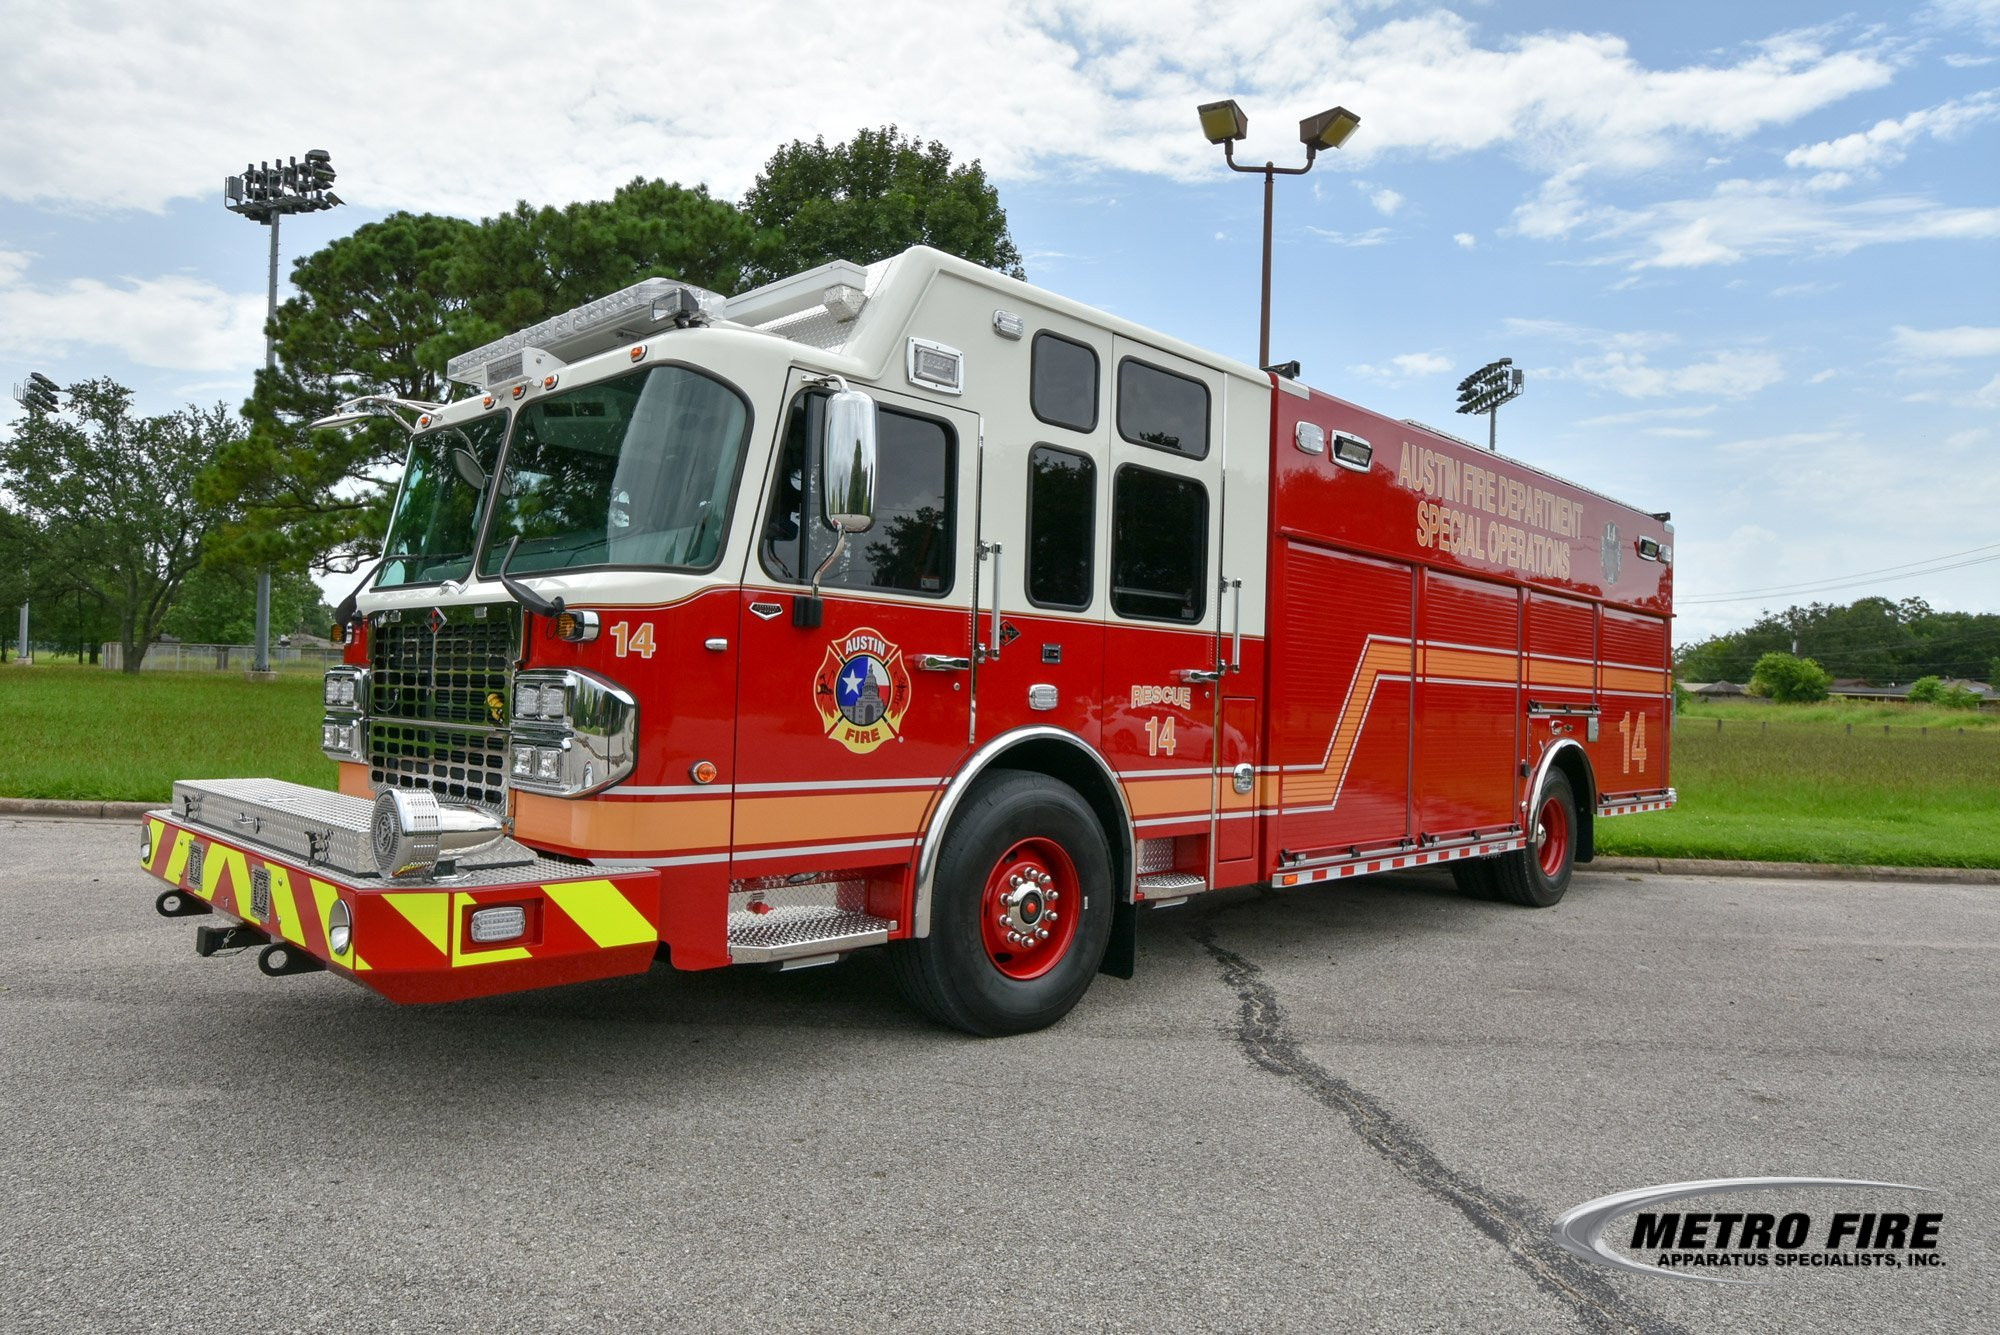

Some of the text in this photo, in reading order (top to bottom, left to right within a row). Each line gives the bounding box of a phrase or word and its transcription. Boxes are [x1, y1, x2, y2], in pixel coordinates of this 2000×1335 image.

[1398, 441, 1584, 540] AUSTIN FIRE DEPARTMENT
[1416, 500, 1571, 581] SPECIAL OPERATIONS
[610, 621, 656, 659] 14
[845, 635, 886, 657] AUSTIN
[1130, 684, 1192, 710] RESCUE
[844, 727, 881, 744] FIRE
[1145, 716, 1176, 757] 14
[1619, 711, 1647, 774] 14
